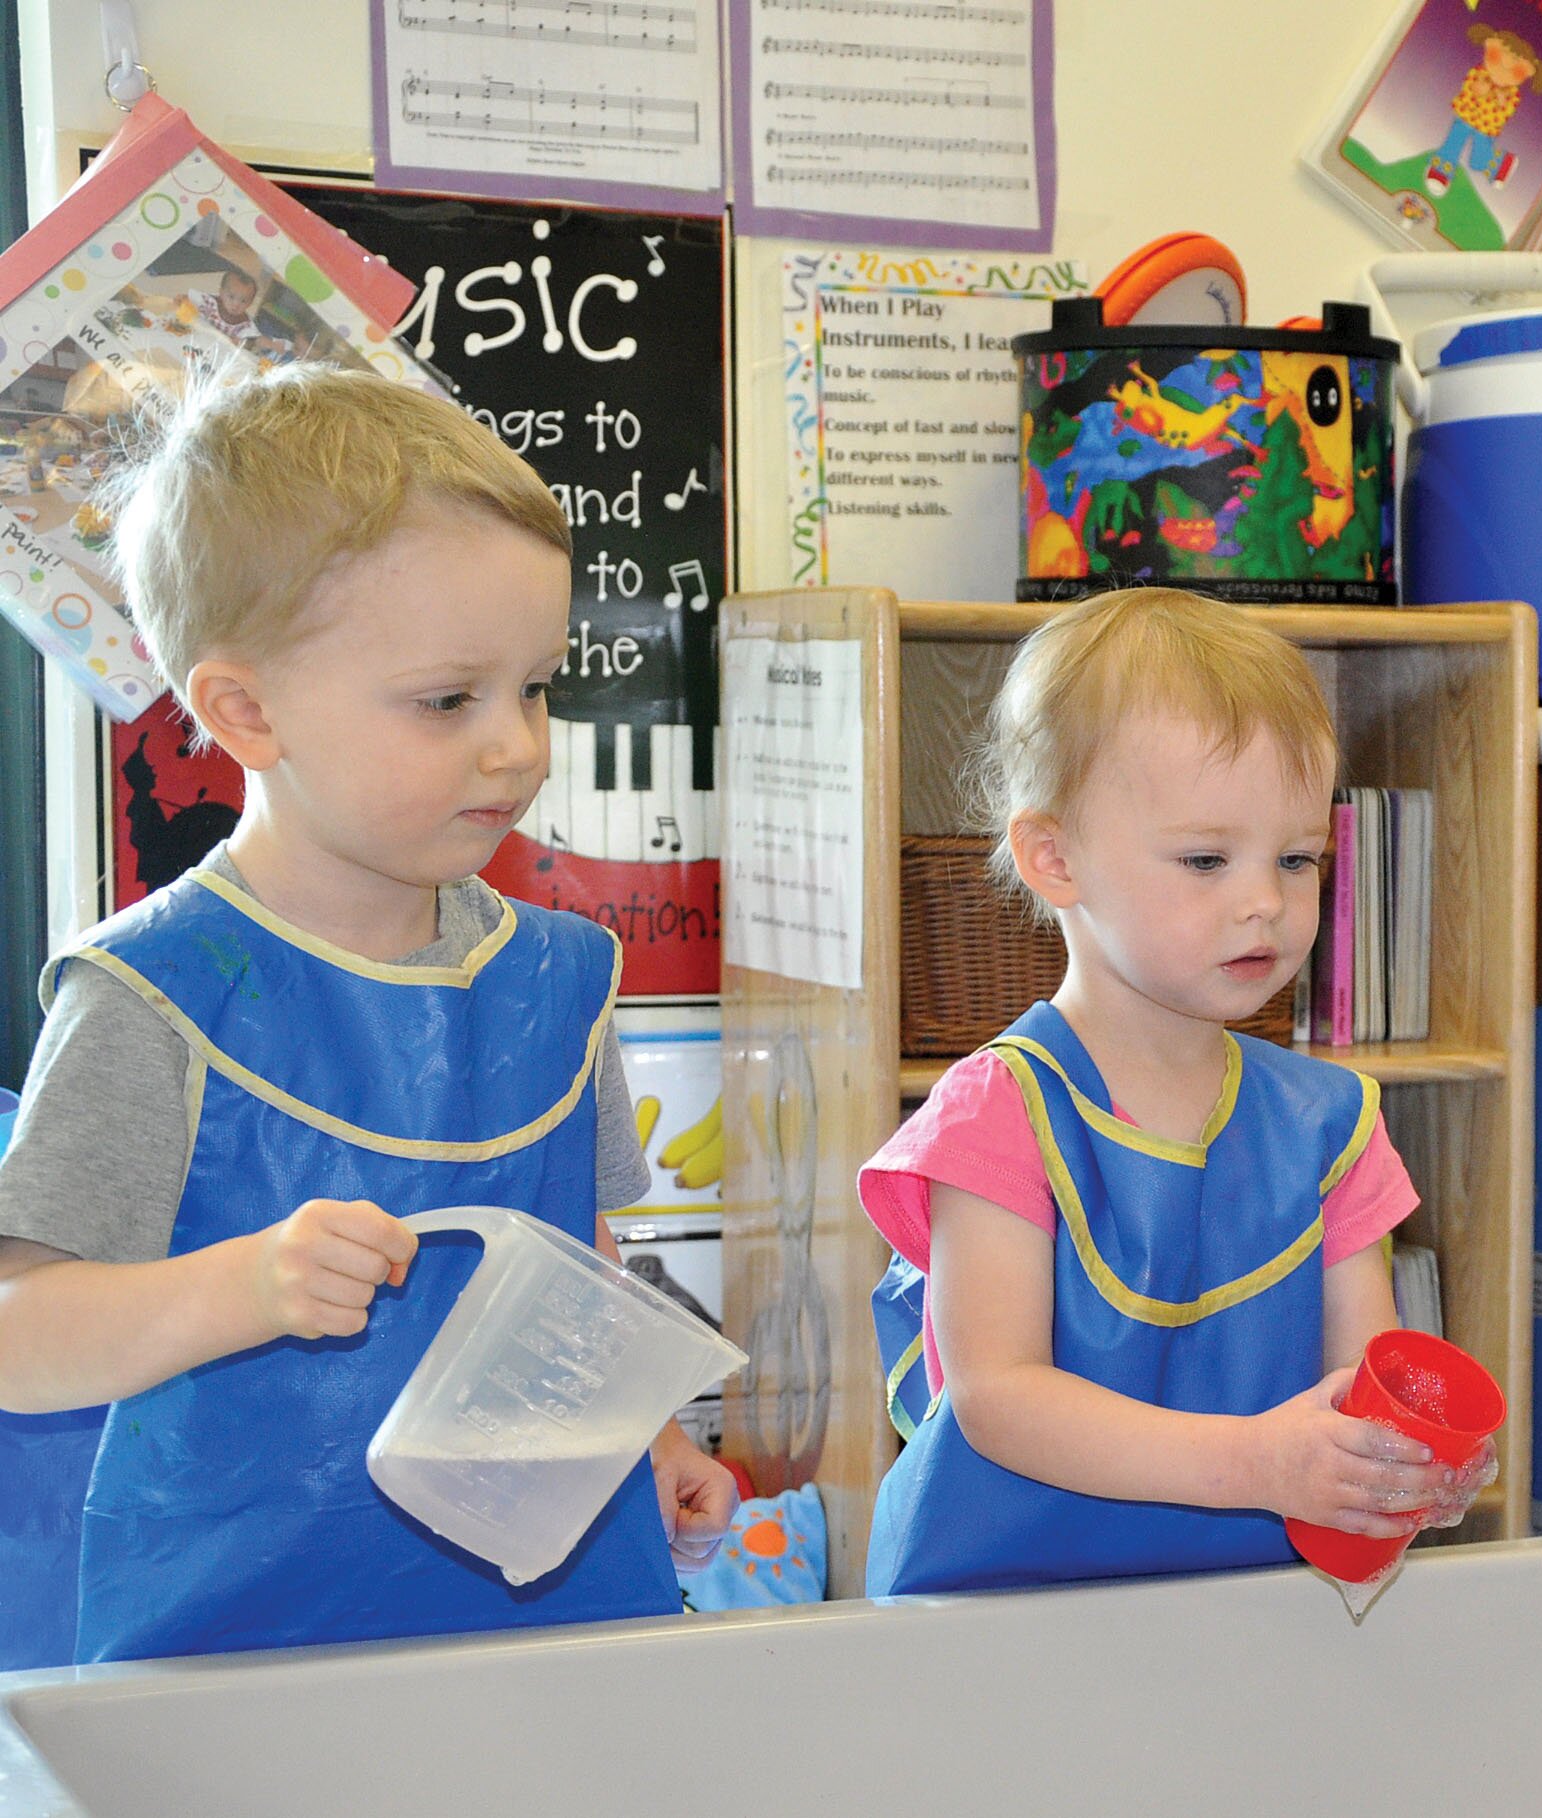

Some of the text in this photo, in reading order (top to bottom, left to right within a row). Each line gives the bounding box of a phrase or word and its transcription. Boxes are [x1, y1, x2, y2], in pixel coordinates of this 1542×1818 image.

[388, 219, 638, 362] usic
[820, 295, 945, 321] When I Play
[78, 324, 106, 350] We
[822, 328, 1010, 353] Instruments, I lea
[822, 364, 1017, 386] To be conscious of rhyth
[824, 391, 876, 404] music.
[453, 386, 642, 454] ngs to
[824, 418, 1017, 436] Concept of fast and slow
[826, 448, 845, 461] To
[850, 451, 911, 466] express
[916, 449, 966, 466] myself
[972, 449, 987, 463] in
[826, 471, 943, 488] different ways.
[828, 501, 952, 518] Listening skills.
[1, 521, 64, 573] paint!
[587, 550, 644, 602] to
